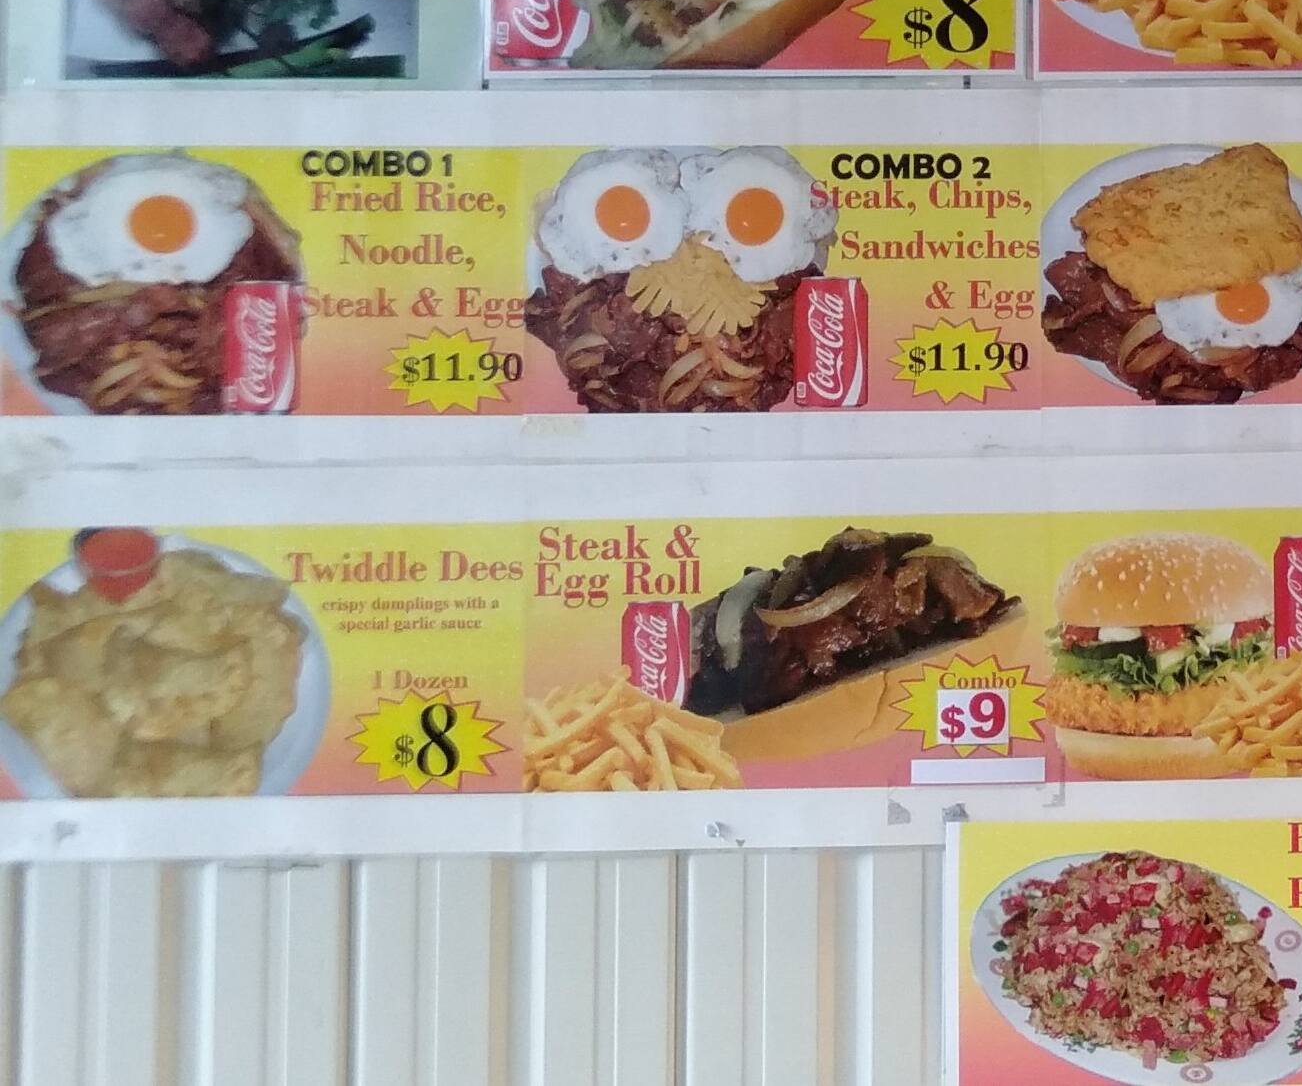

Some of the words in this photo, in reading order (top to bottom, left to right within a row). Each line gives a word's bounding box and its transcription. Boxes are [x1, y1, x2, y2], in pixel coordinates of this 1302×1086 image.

[301, 151, 431, 178] COMBO
[442, 152, 452, 177] 1
[832, 154, 961, 180] COMBO
[973, 157, 991, 179] 2
[310, 181, 400, 213] Fried
[414, 182, 506, 218] Rice,
[810, 180, 916, 215] Steak,
[929, 181, 1032, 218] Chips,
[339, 235, 475, 271] Noodle,
[841, 230, 1040, 260] Sandwiches
[402, 353, 524, 387] $11.90
[909, 342, 1029, 377] $11.90
[289, 551, 427, 584] Twiddle
[439, 550, 524, 581] Dees
[322, 597, 365, 617] crispy
[371, 595, 450, 616] dumplings
[455, 596, 486, 611] with
[491, 600, 500, 610] a
[339, 616, 389, 635] special
[394, 615, 437, 635] garlic
[442, 619, 481, 630] sauce
[372, 670, 382, 689] 1
[394, 670, 468, 691] Dozen
[939, 671, 1017, 689] Combo
[940, 692, 1007, 743] $9
[394, 702, 458, 778] $8
